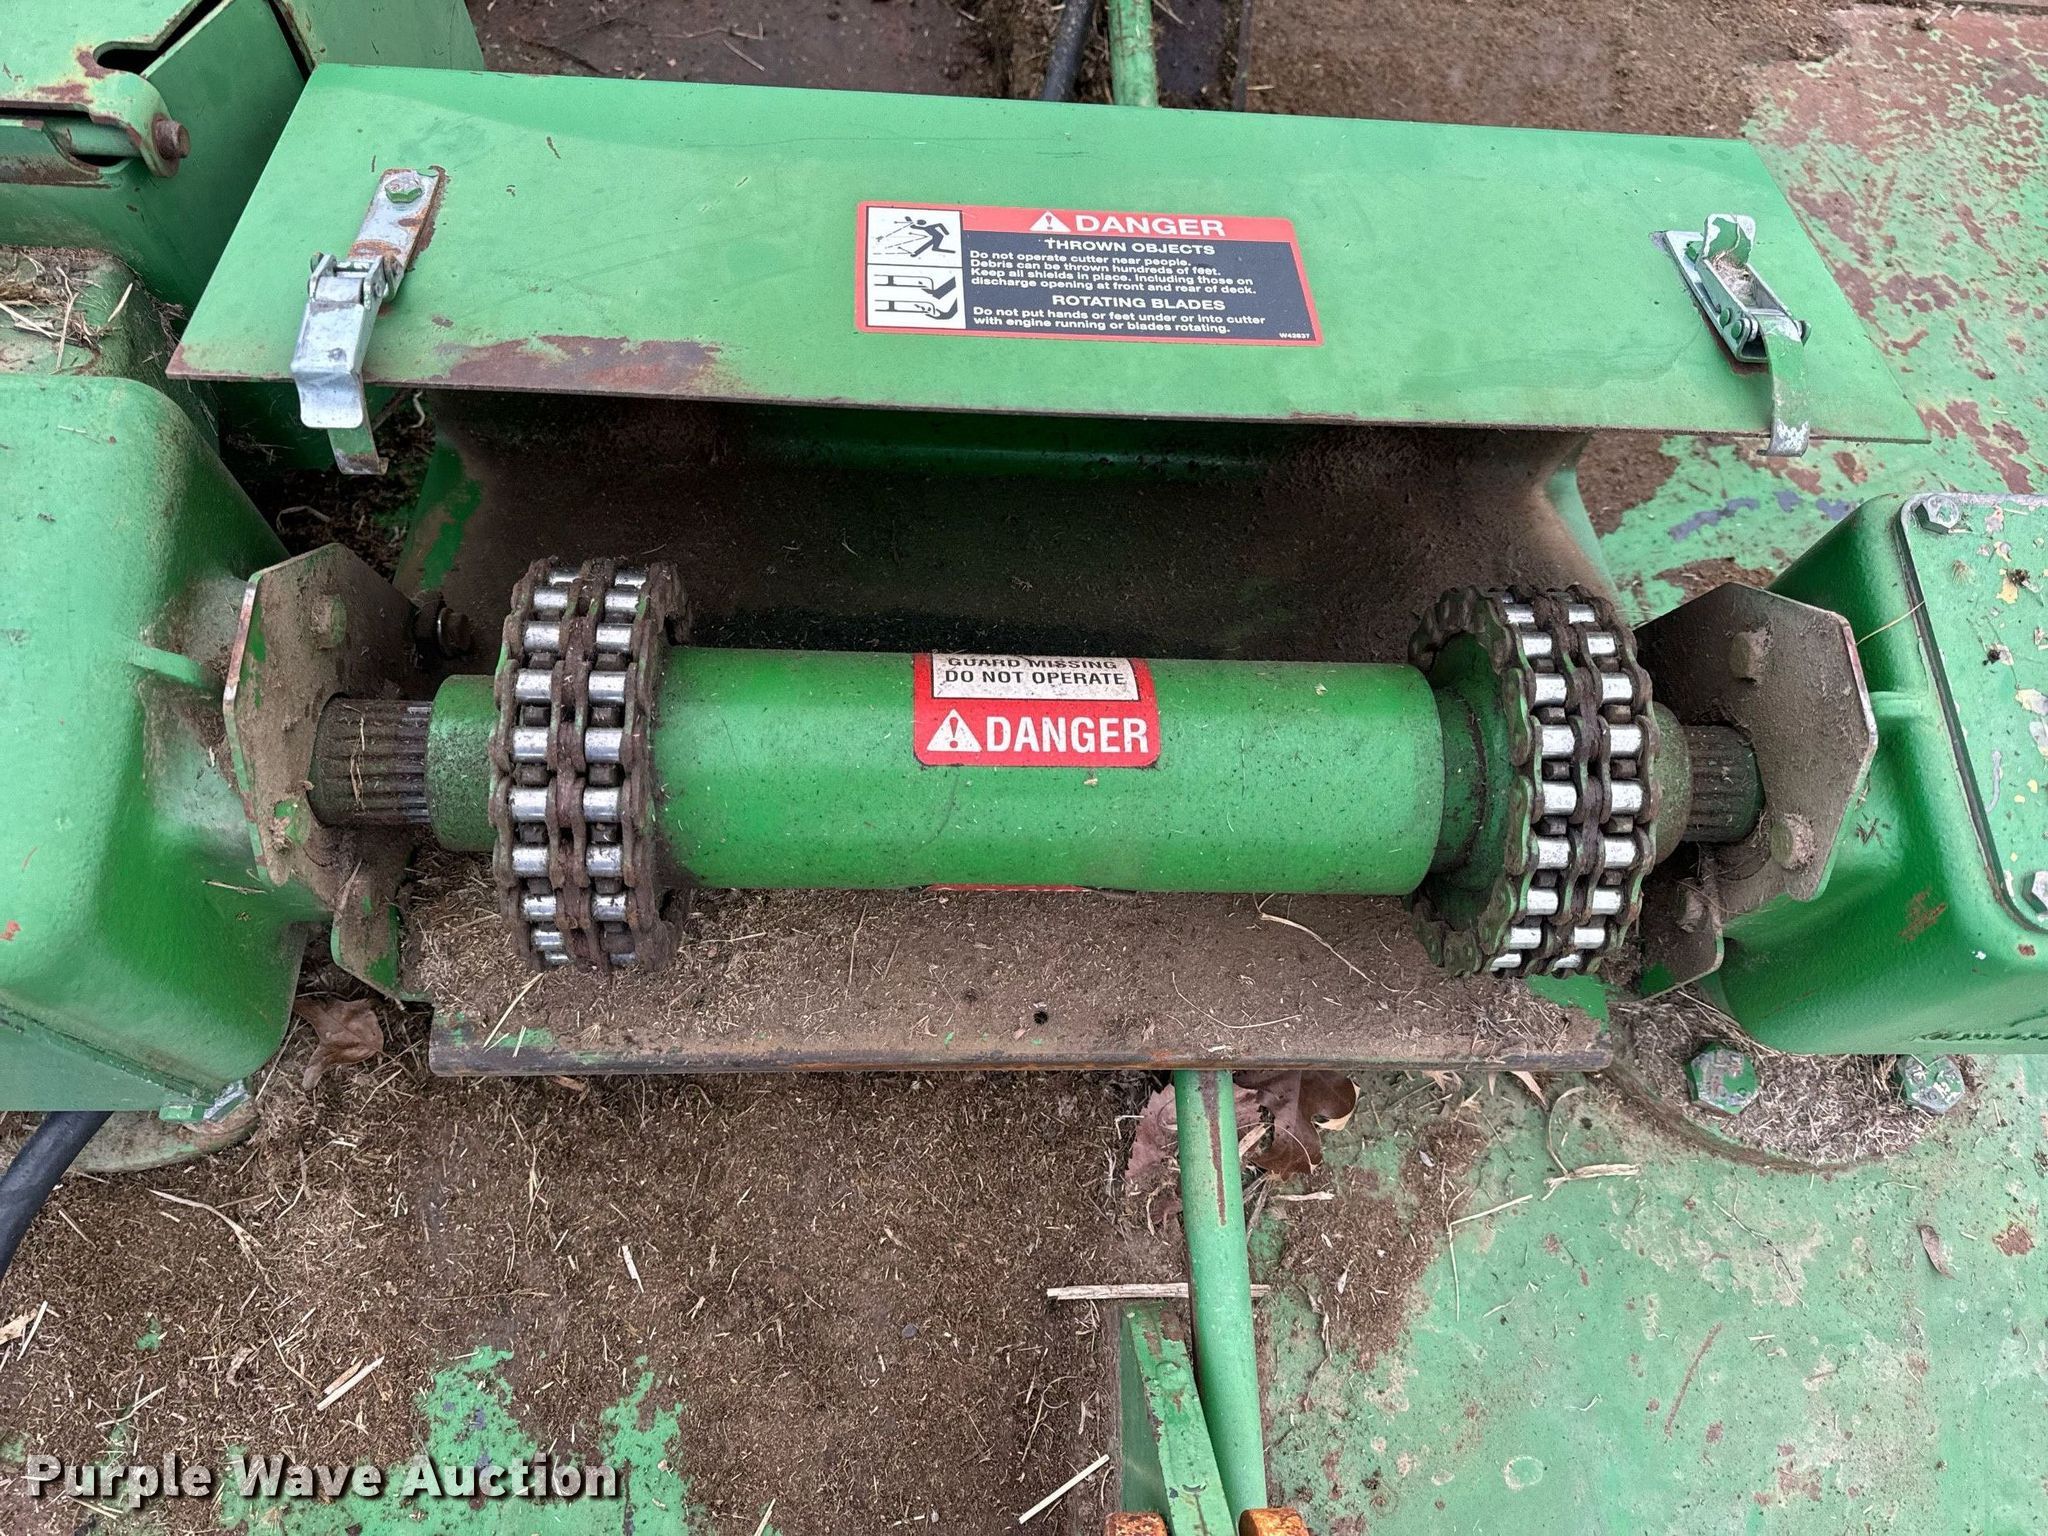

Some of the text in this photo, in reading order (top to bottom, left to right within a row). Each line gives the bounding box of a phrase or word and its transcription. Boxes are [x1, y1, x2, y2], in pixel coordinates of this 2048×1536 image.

[1074, 214, 1226, 237] DANGER
[1044, 238, 1216, 255] THROWN OBJECTS
[970, 250, 1191, 267] Do not operate cutter near people.
[970, 259, 1221, 276] Debris can be thrown hundreds of feet.
[971, 268, 1005, 279] Keep
[1009, 269, 1024, 278] all
[1028, 270, 1074, 280] shields
[1077, 272, 1089, 280] in
[1197, 275, 1233, 285] those
[971, 277, 1257, 294] discharge opening at front and rear of deck.
[1052, 295, 1226, 311] ROTATING BLADES
[973, 306, 1266, 325] Do not put hands or feet under or into cutter
[974, 316, 1230, 334] with engine running or blades rotating.
[948, 657, 1118, 670] GUARD MISSING
[945, 670, 1126, 685] DO NOT OPERATE
[986, 716, 1149, 753] DANGER
